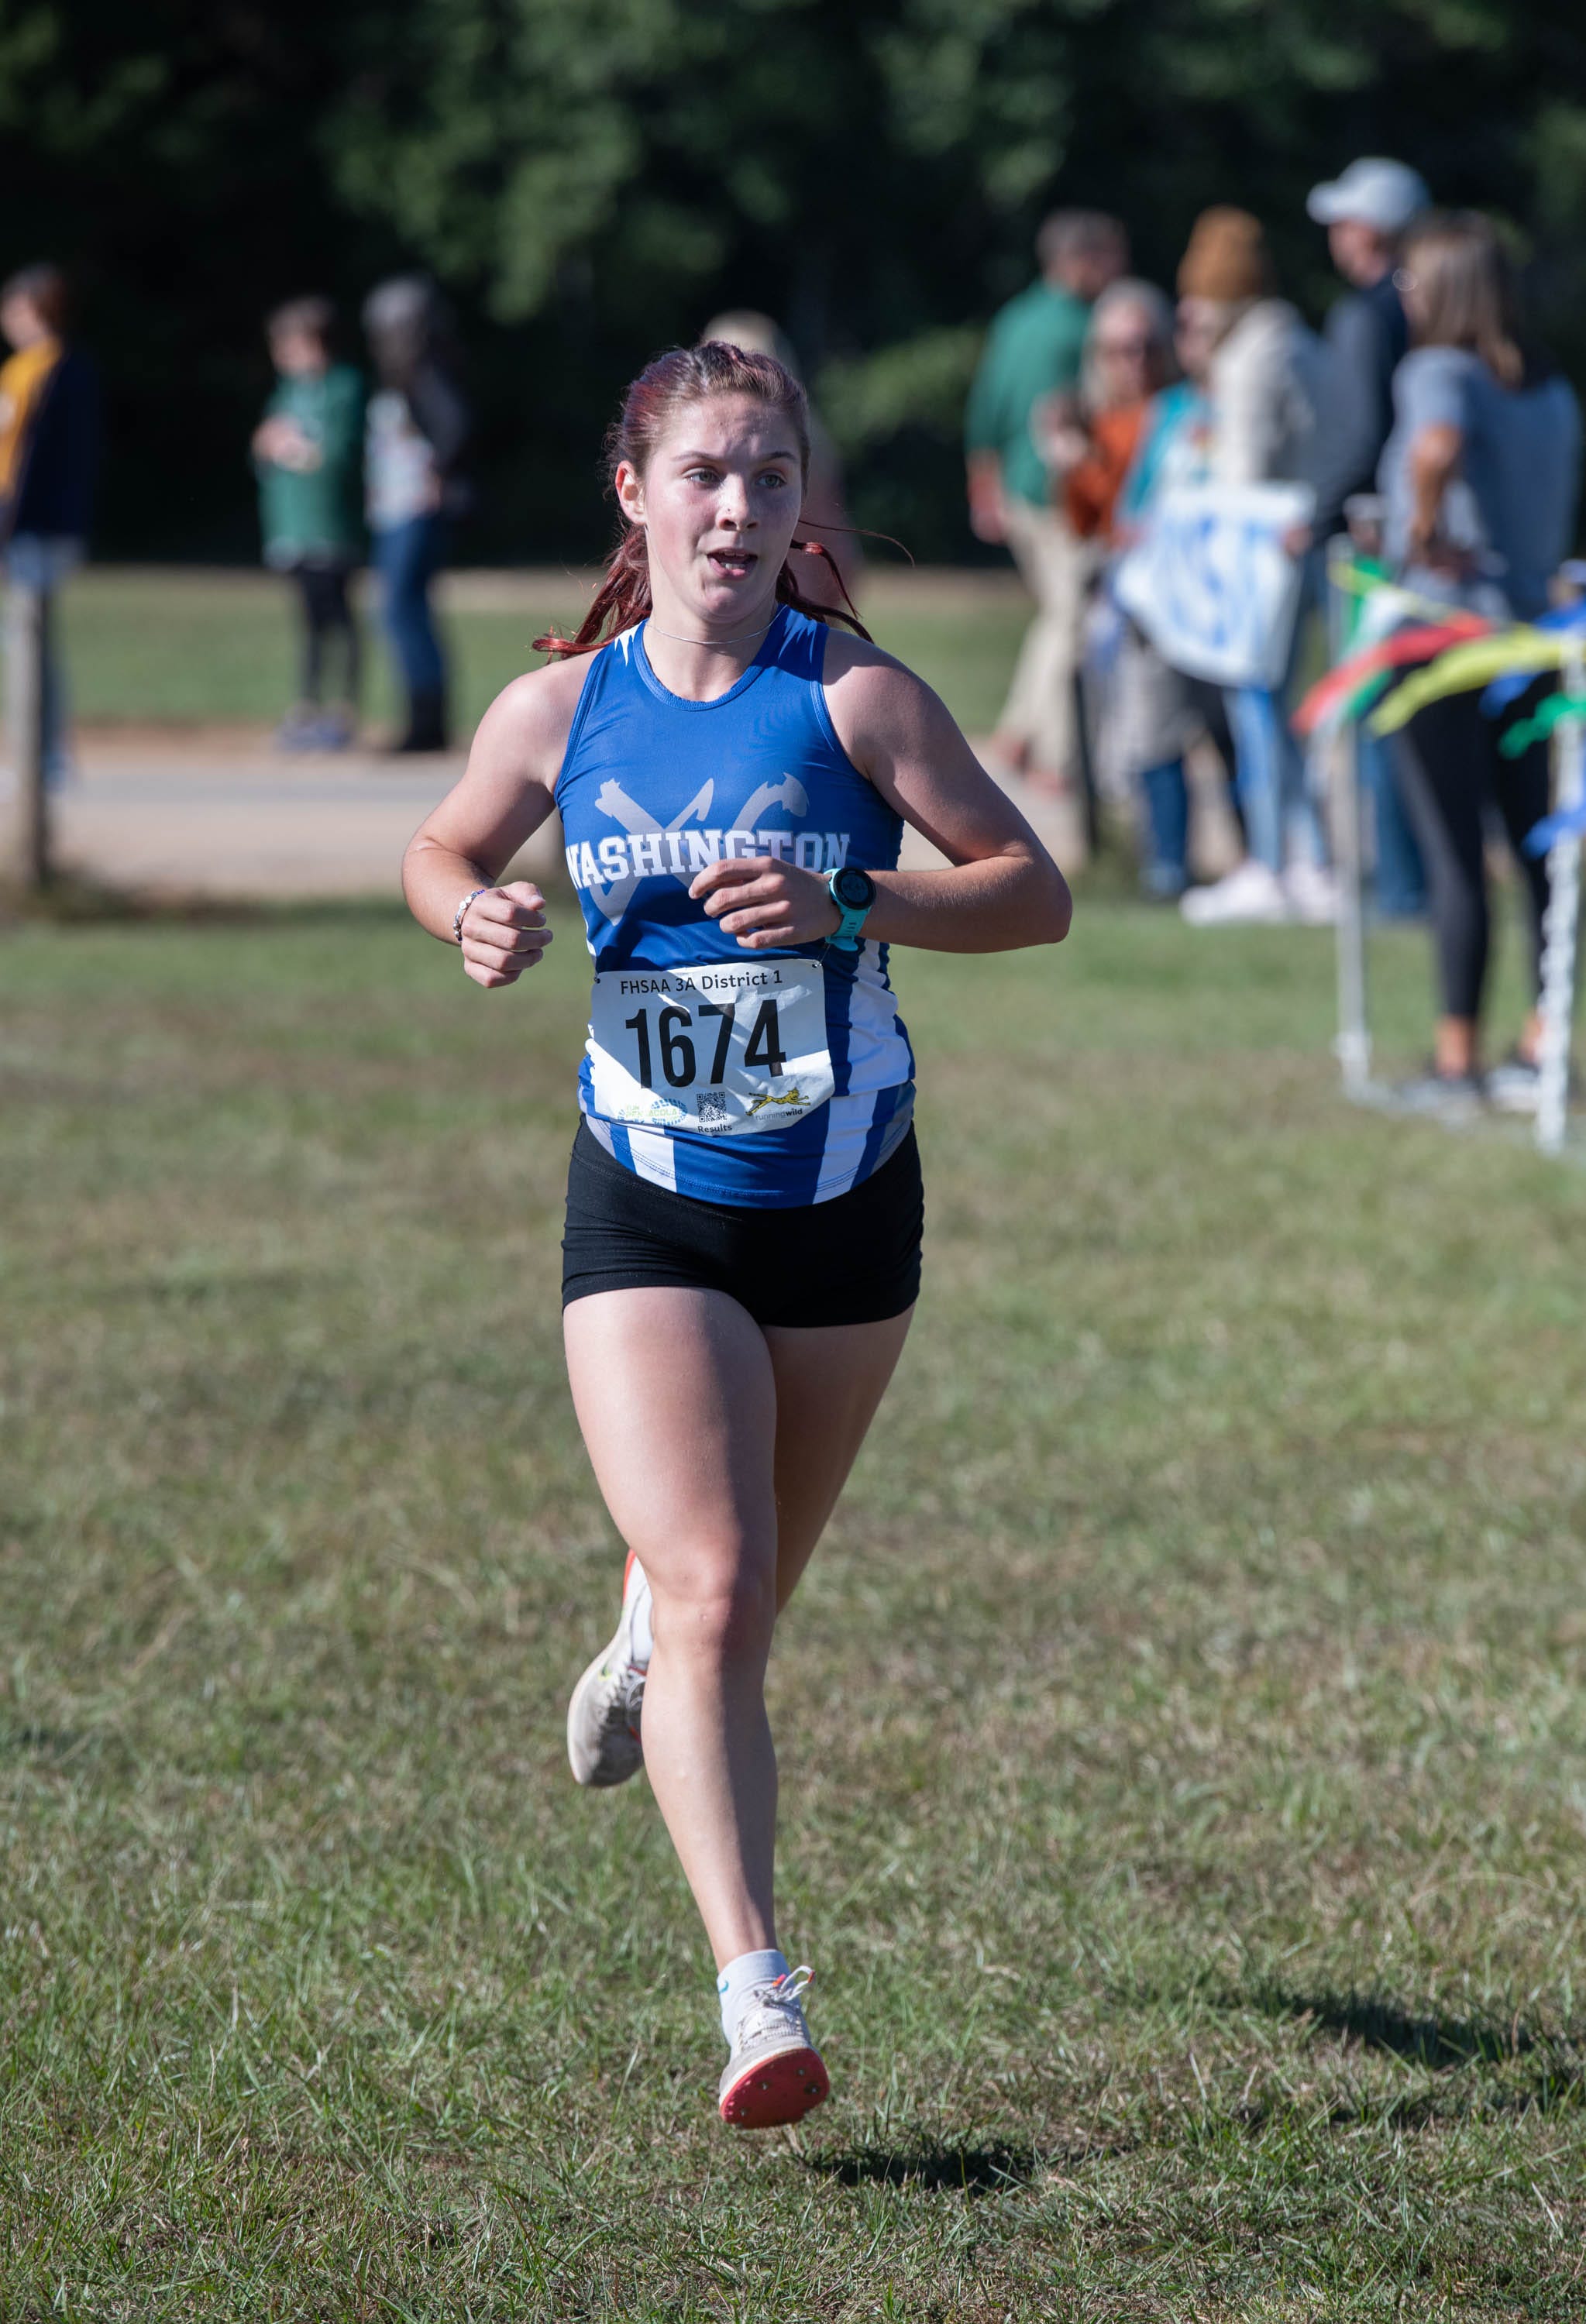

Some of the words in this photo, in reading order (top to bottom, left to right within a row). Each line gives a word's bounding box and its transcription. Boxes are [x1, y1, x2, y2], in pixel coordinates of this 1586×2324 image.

[565, 830, 851, 891] WASHINGTON
[621, 978, 671, 995] FHSAA
[676, 977, 697, 992] 3A
[701, 971, 769, 990] District
[773, 970, 783, 985] 1
[625, 999, 786, 1089] 1674
[697, 1123, 733, 1133] Results
